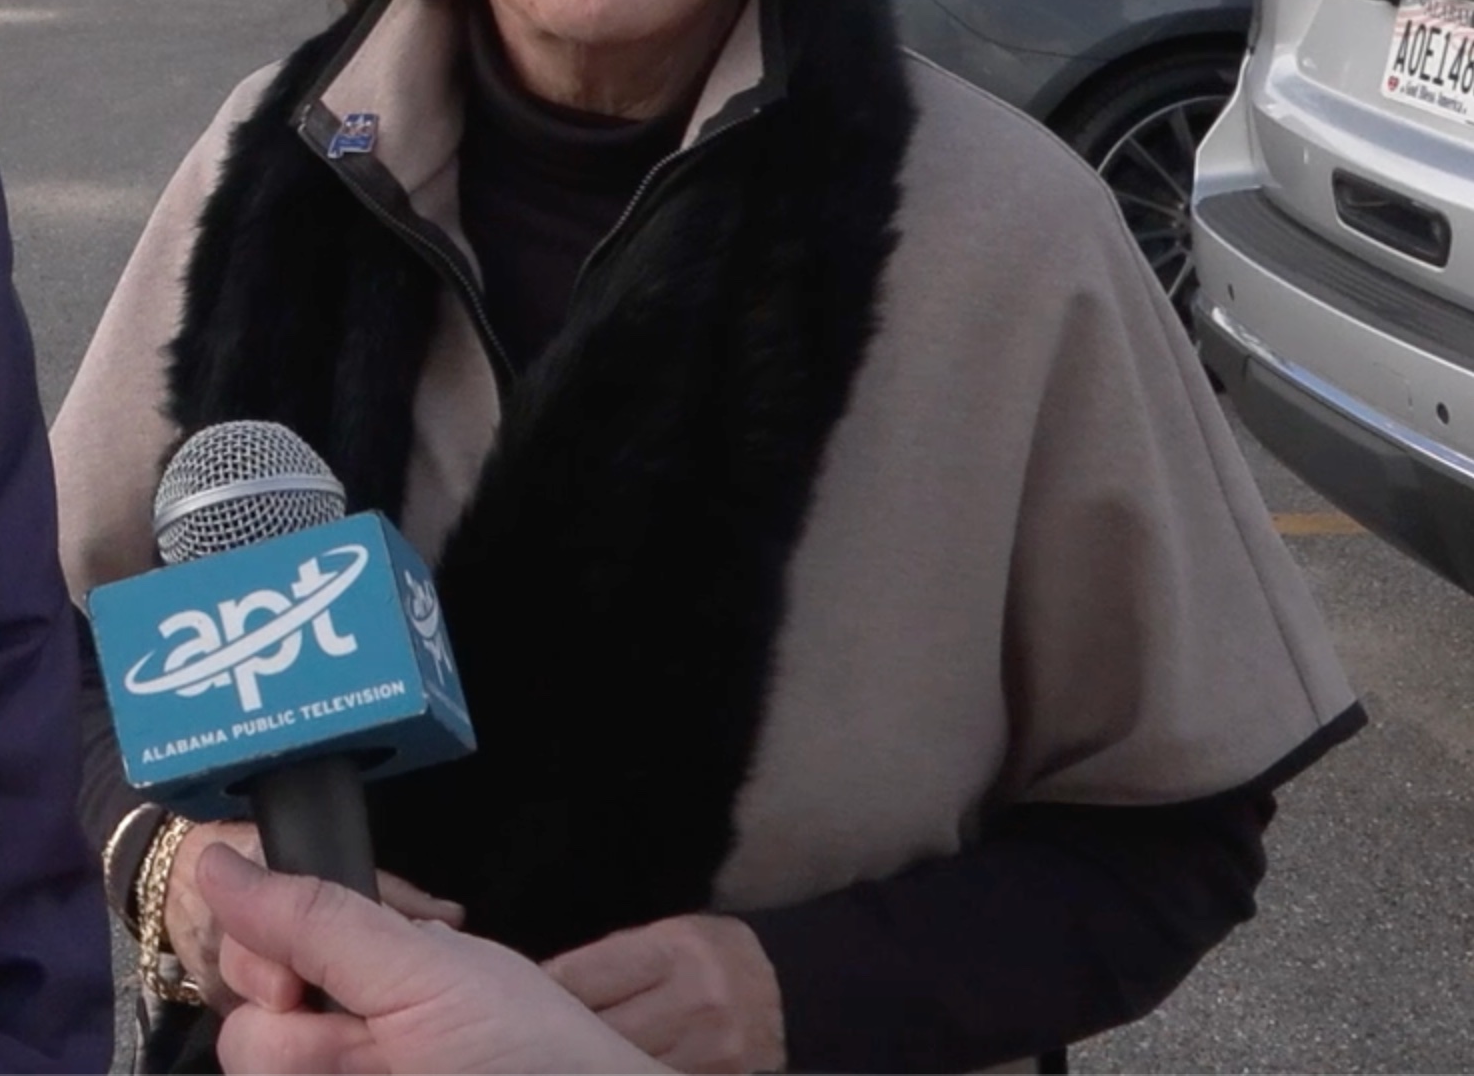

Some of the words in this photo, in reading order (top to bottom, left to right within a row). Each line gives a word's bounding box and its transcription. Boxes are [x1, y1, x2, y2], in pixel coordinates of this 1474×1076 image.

[158, 557, 358, 712] apt
[141, 728, 228, 764] ALABAMA
[232, 709, 296, 739] PUBLIC
[300, 680, 406, 721] TELEVISION
